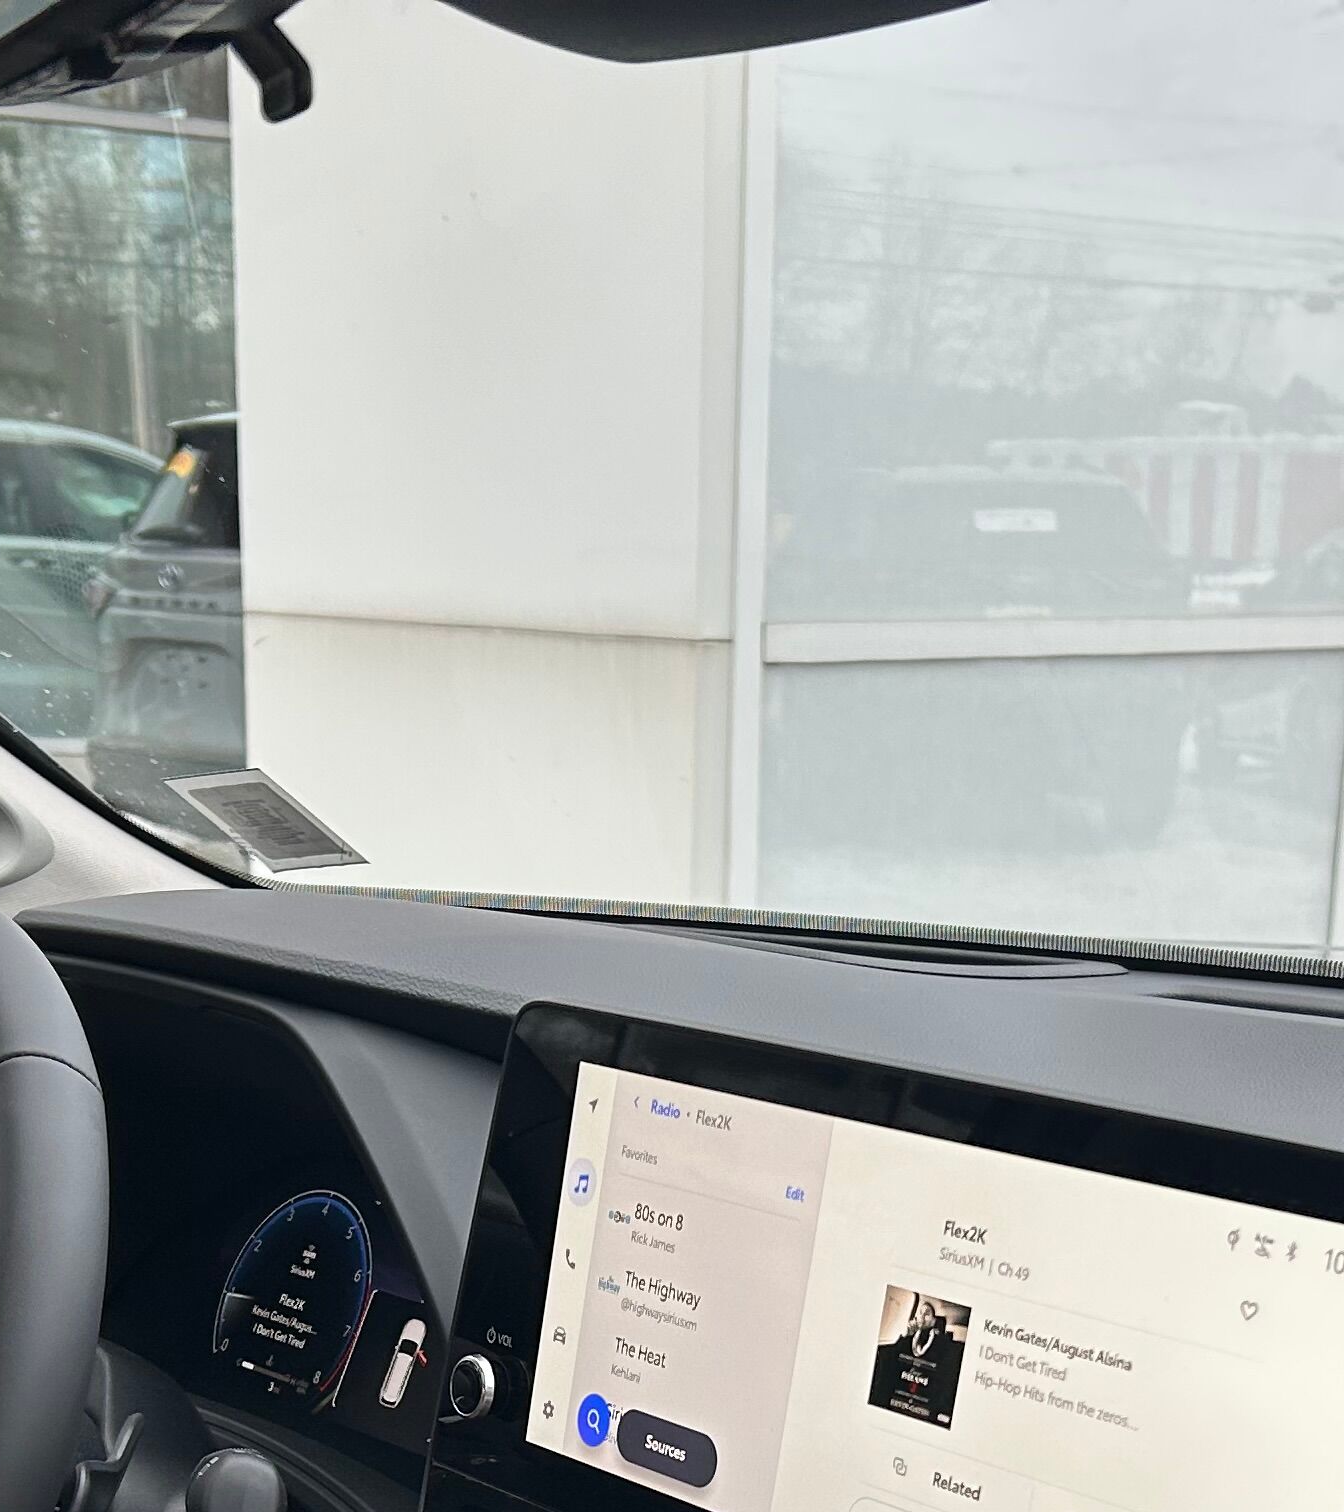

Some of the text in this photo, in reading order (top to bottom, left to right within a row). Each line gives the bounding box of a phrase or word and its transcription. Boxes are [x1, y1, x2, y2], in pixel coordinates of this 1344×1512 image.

[650, 1098, 681, 1119] Radio
[695, 1109, 732, 1131] Flex2K
[621, 1144, 658, 1166] Favorites
[785, 1185, 805, 1203] Edit
[634, 1203, 655, 1225] 80s
[657, 1211, 673, 1229] on
[675, 1213, 684, 1231] 8
[630, 1230, 676, 1254] Rick James
[943, 1220, 989, 1245] Flex2K
[938, 1247, 1031, 1282] SiriusXM Ch 49
[624, 1270, 645, 1292] The
[647, 1276, 702, 1311] Highway
[614, 1337, 666, 1369] The Heat
[983, 1318, 1133, 1372] Kevin Gates/August Alsina
[610, 1363, 641, 1385] Kehlani
[984, 1346, 1014, 1367] Don't
[1016, 1354, 1037, 1373] Get
[1038, 1361, 1067, 1382] Tired
[974, 1370, 1021, 1398] Hip-Hop
[1023, 1381, 1045, 1403] Hits
[1046, 1388, 1074, 1412] from
[1076, 1398, 1095, 1418] the
[644, 1434, 686, 1462] Sources
[932, 1471, 982, 1501] Related
